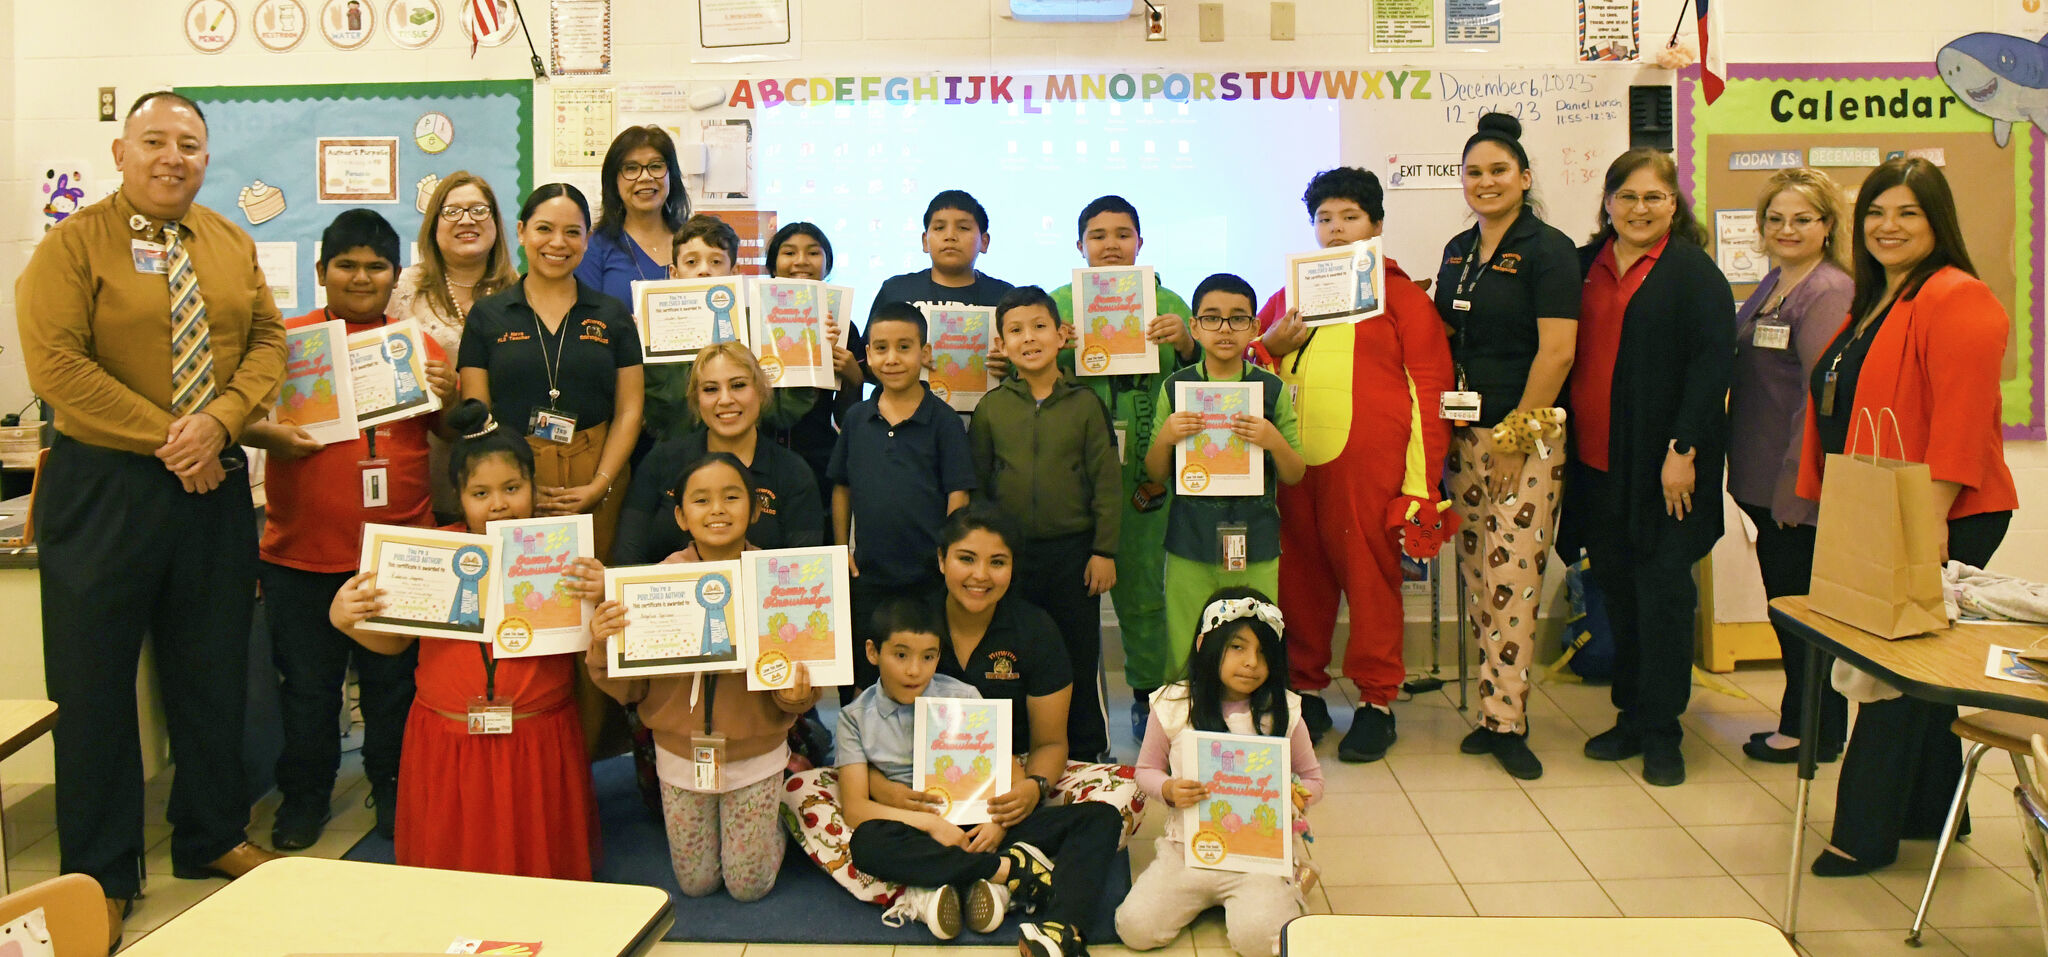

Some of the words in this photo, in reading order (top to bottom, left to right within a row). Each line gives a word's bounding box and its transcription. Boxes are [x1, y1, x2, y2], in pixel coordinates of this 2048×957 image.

[399, 30, 428, 38] TISSUE
[1556, 99, 1590, 111] Daniel
[1771, 88, 1956, 123] Calendar
[1734, 153, 1775, 166] TODAY
[1781, 152, 1800, 166] IS:
[1812, 148, 1878, 163] DECEMBER
[1400, 165, 1422, 177] EXIT
[1426, 164, 1463, 177] TICKET
[763, 595, 832, 609] Knowledge
[931, 739, 995, 754] Knowledge
[1205, 781, 1280, 803] Knowledge
